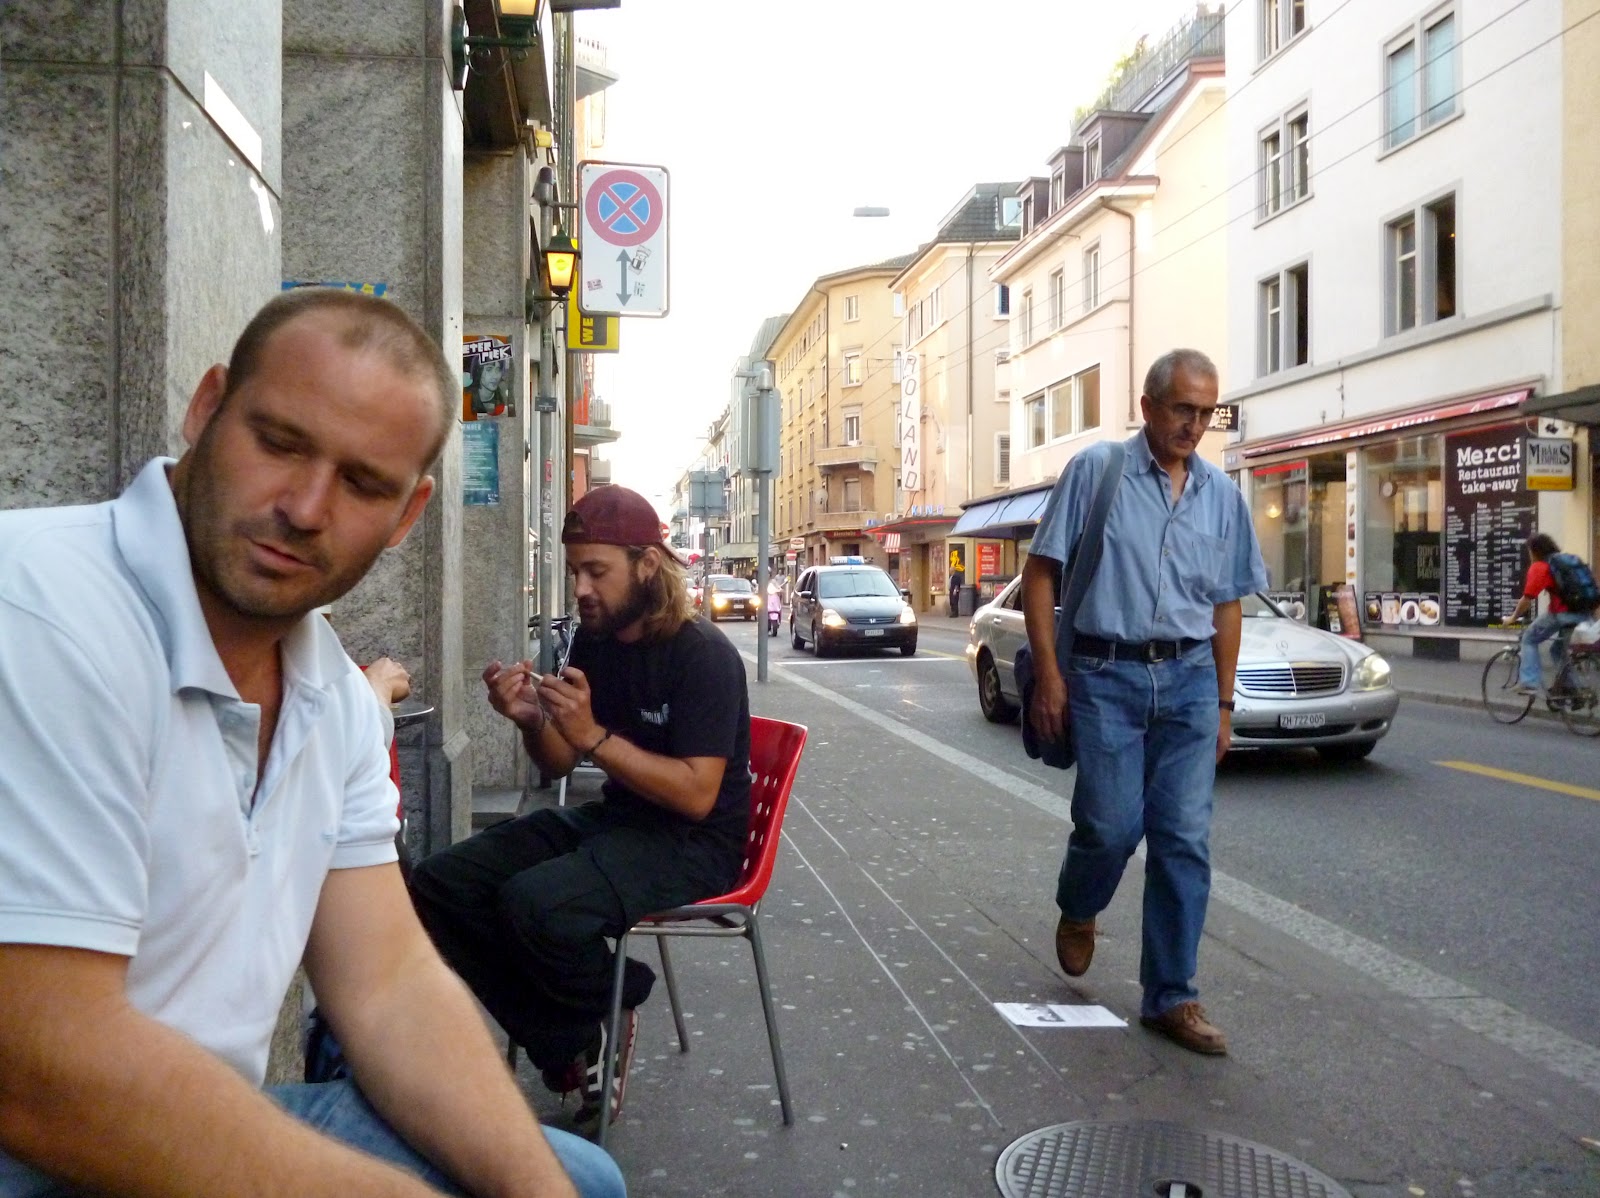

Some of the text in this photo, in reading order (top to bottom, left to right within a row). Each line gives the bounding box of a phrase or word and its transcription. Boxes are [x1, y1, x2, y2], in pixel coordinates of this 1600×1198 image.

[463, 342, 492, 354] ETER
[903, 354, 918, 489] ROLAND
[1456, 437, 1520, 467] Merci
[1458, 462, 1520, 481] Restaurant
[1461, 478, 1519, 494] take-away
[911, 504, 944, 516] KINO
